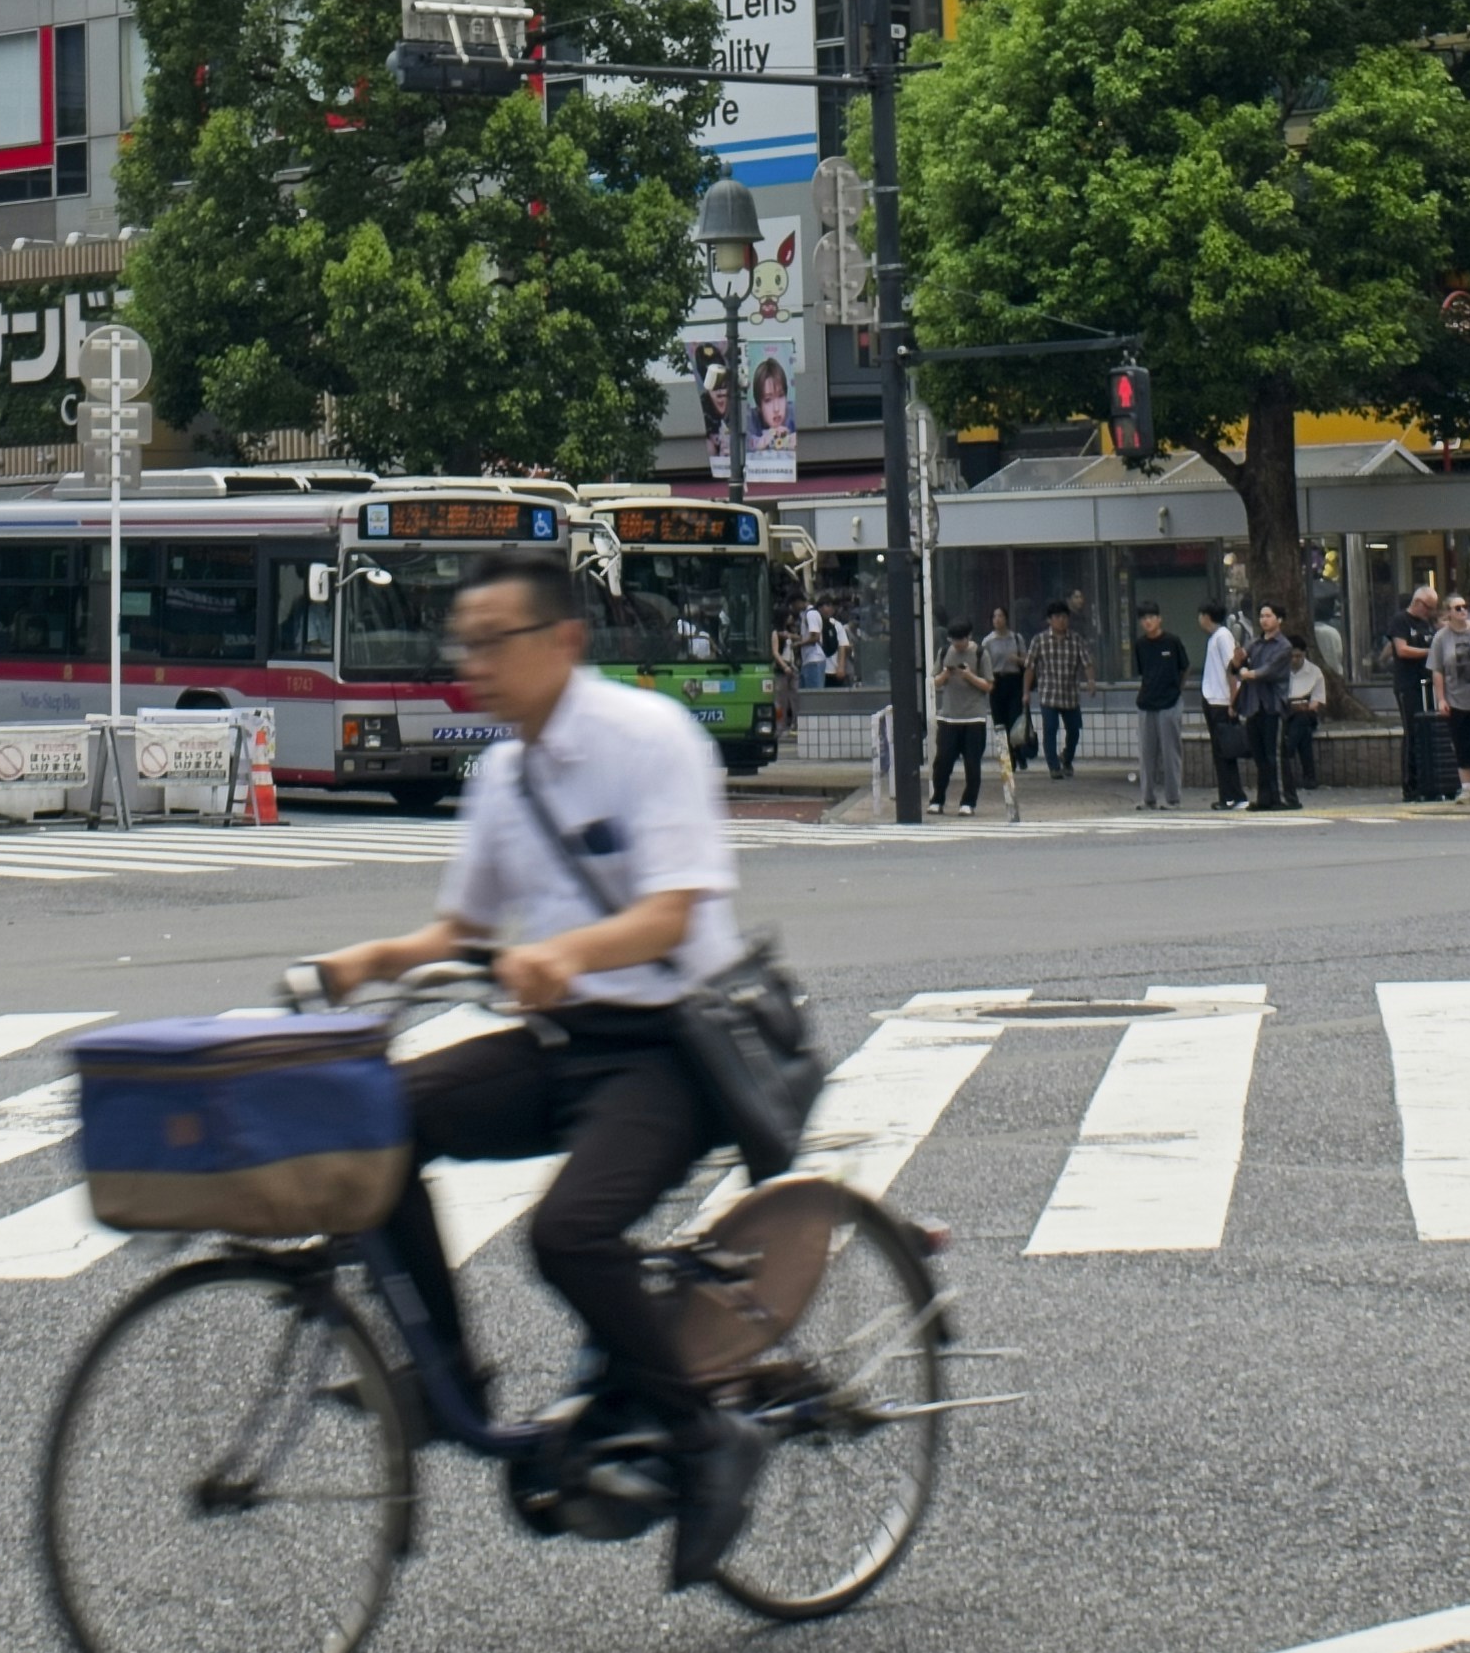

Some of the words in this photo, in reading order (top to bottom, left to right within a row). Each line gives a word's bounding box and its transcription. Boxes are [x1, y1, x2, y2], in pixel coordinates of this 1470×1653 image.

[432, 726, 515, 740] ノンステップバス
